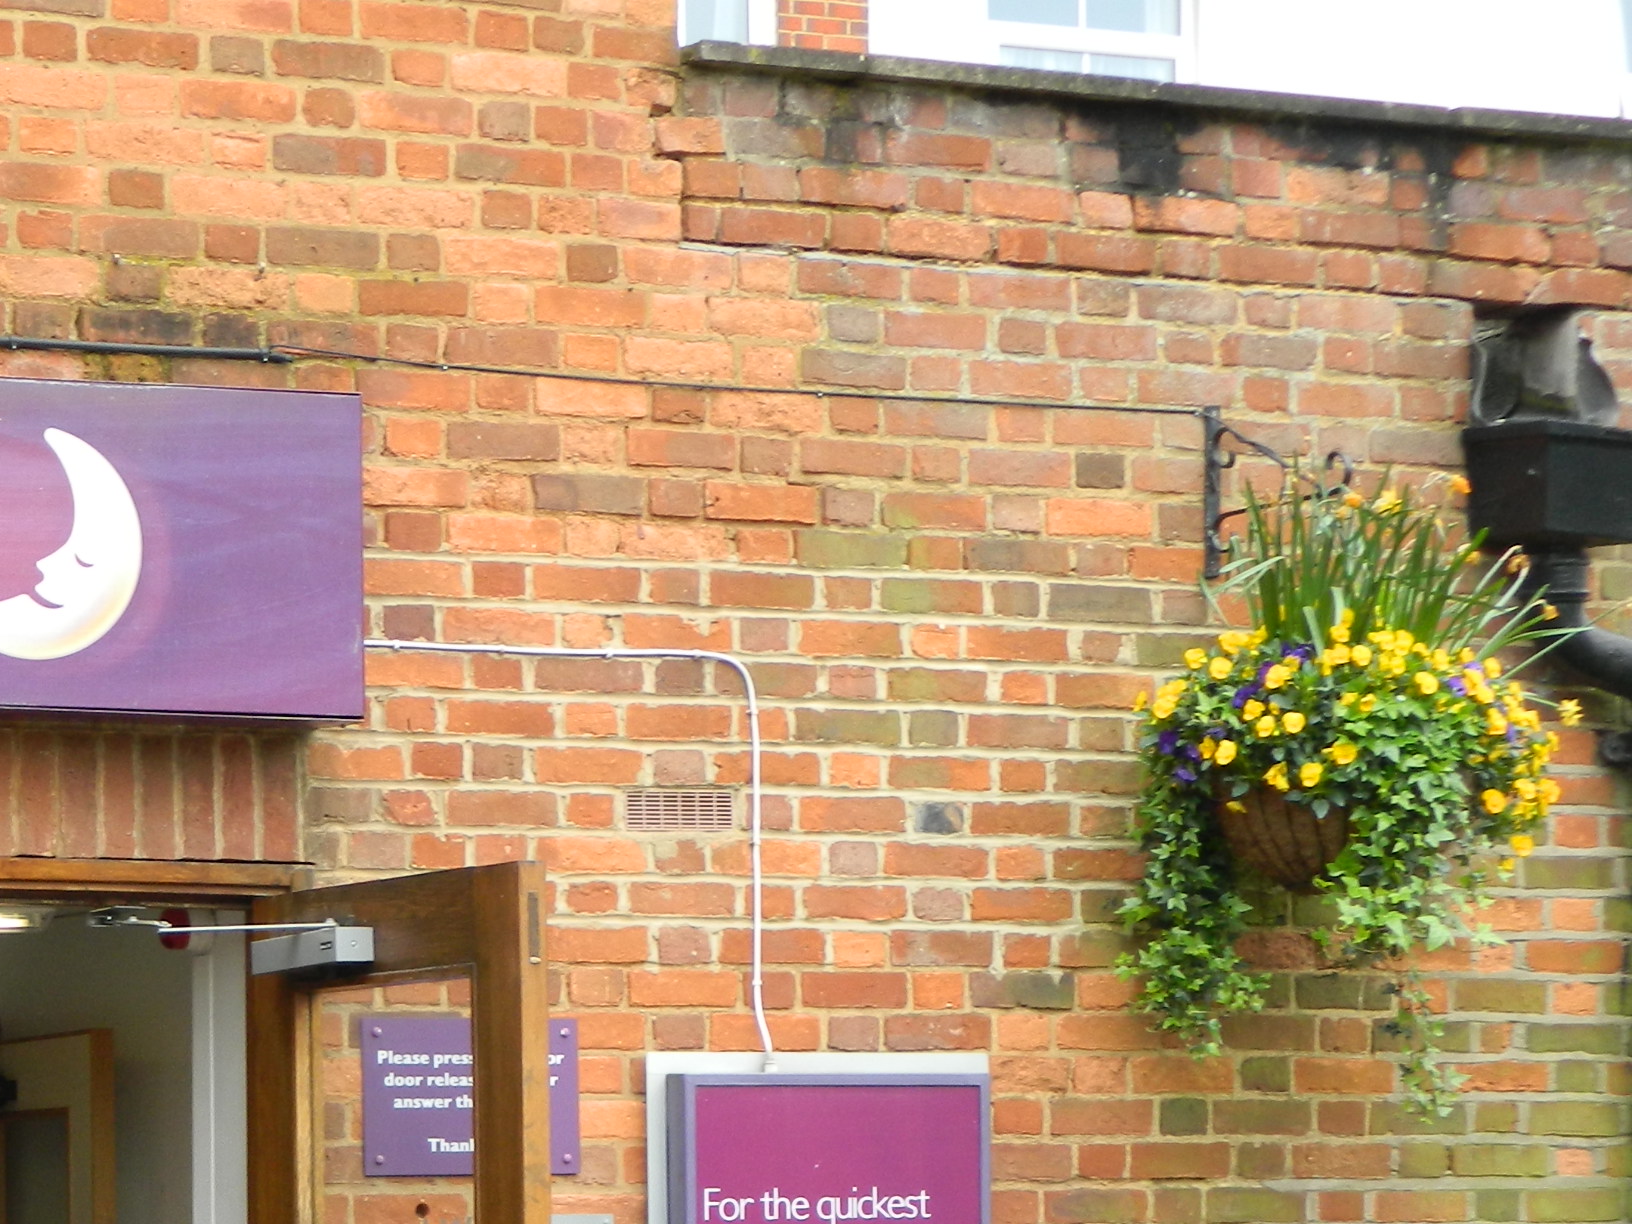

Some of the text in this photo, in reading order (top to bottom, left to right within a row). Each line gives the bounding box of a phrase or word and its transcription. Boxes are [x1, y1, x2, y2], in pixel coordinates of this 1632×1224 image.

[377, 1050, 430, 1064] Please
[384, 1072, 423, 1086] door
[426, 1072, 473, 1086] releas
[393, 1094, 473, 1109] answer th
[703, 1188, 754, 1221] For
[760, 1187, 810, 1220] the
